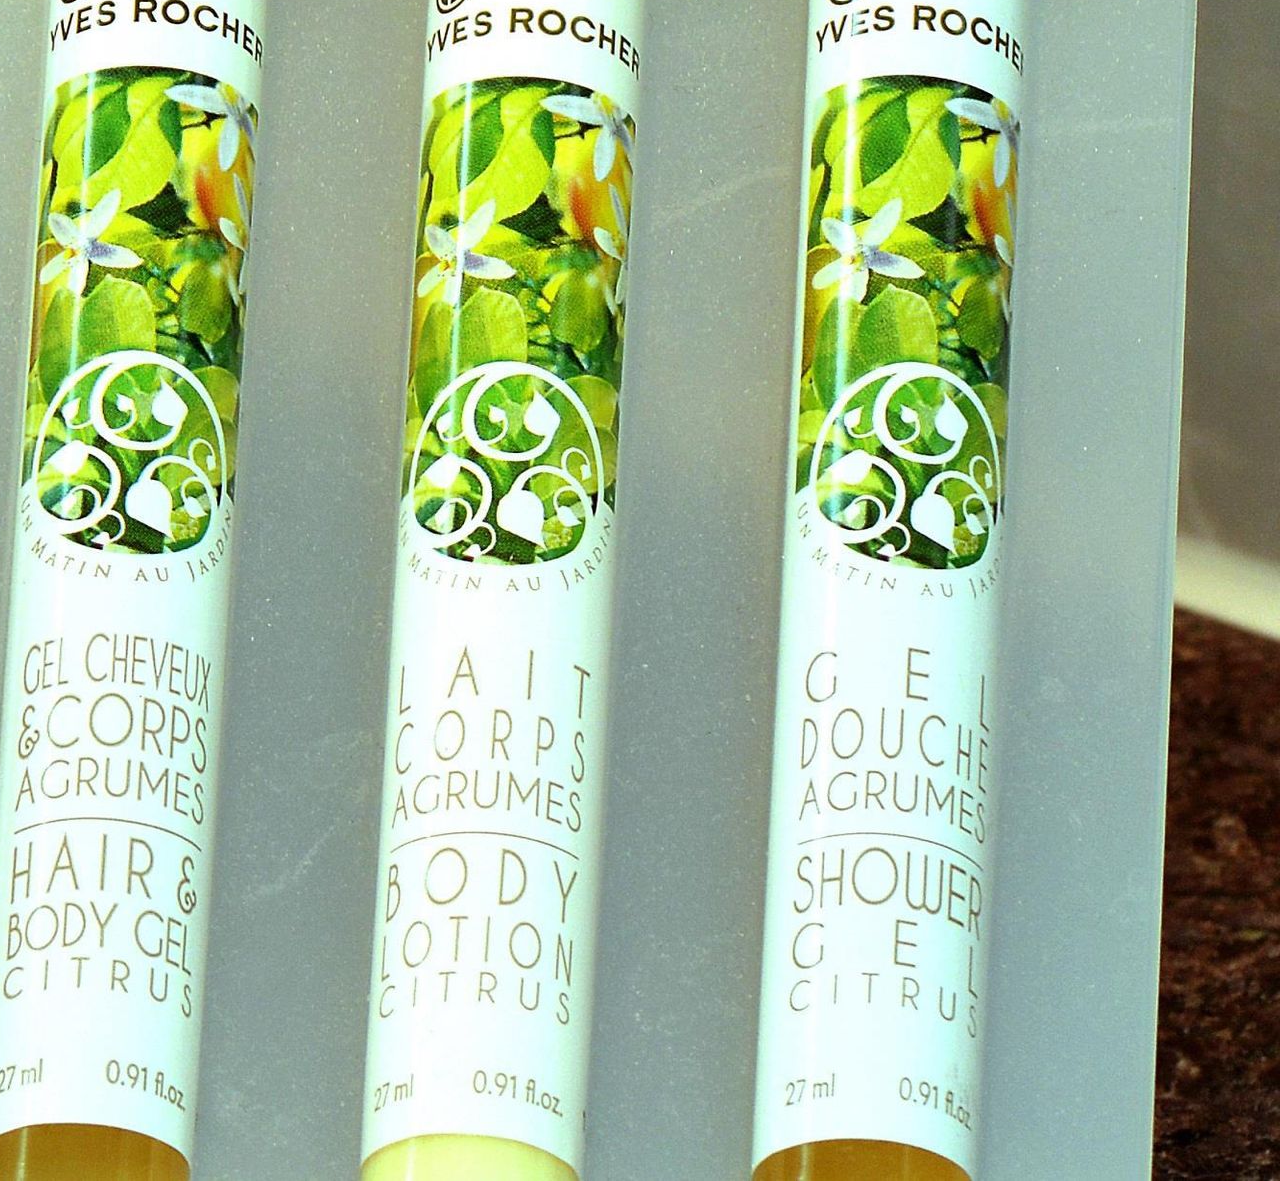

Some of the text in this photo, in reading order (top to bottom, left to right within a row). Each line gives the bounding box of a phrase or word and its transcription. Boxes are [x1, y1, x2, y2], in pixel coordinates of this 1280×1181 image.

[50, 0, 116, 52] YVES
[426, 7, 640, 81] YVES ROCHER
[816, 5, 895, 53] YVES
[31, 537, 112, 578] MATIN
[135, 567, 169, 582] AU
[187, 509, 231, 583] JARDIN
[506, 576, 541, 592] AU
[559, 518, 611, 591] JARDIN
[920, 582, 953, 598] AU
[23, 633, 211, 713] GEL CHEVEUX
[399, 646, 591, 719] LAIT
[806, 647, 989, 733] GEL
[395, 709, 585, 784] CORPS
[801, 707, 988, 794] DOUCHE
[15, 756, 204, 825] AGRUMES
[392, 769, 581, 833] AGRUMES
[799, 770, 986, 844] AGRUMES
[10, 833, 197, 914] HAIR &
[386, 847, 578, 923] BODY
[793, 846, 982, 941] SHOWER
[6, 901, 192, 977] BODY GEL
[380, 916, 573, 987] LOTION
[792, 919, 978, 999] GEL
[3, 957, 192, 1018] CITRUS
[378, 971, 570, 1025] CITRUS
[790, 972, 977, 1039] CITRUS
[21, 1058, 43, 1086] ml
[105, 1059, 148, 1092] 0.91
[374, 1082, 390, 1112] 27
[394, 1074, 414, 1102] ml
[473, 1069, 517, 1099] 0.91
[785, 1079, 806, 1107] 27
[813, 1073, 835, 1100] ml
[899, 1076, 938, 1109] 0.91
